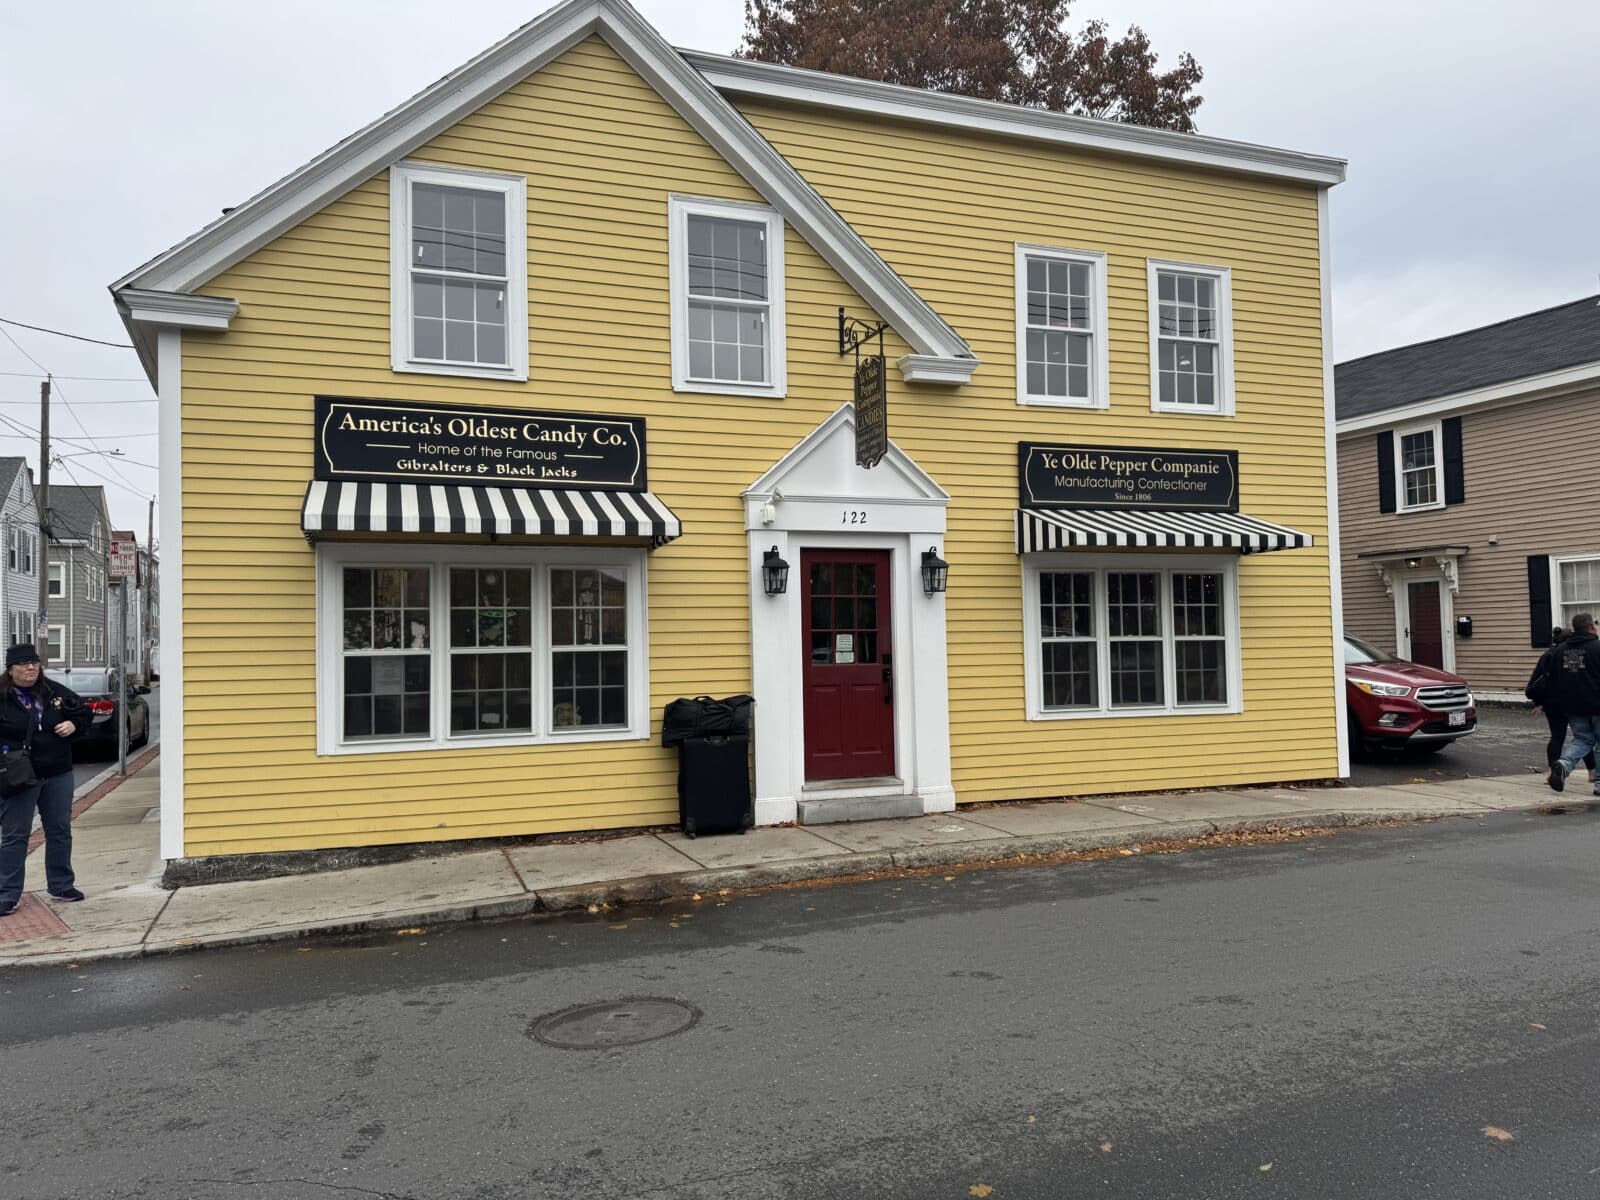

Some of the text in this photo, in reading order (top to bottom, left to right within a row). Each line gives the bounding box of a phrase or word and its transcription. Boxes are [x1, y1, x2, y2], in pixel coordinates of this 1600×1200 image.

[856, 407, 884, 432] CANDIES
[338, 412, 628, 449] America's Oldest Candy Co.
[418, 442, 557, 460] Home of the Famous
[396, 459, 578, 478] Gibralters & Black Jacks
[1041, 453, 1220, 477] Ye Olde Pepper Companie
[1055, 475, 1207, 491] Manufacturing Confectioner
[1114, 492, 1152, 501] Since 1806
[842, 511, 867, 524] 122
